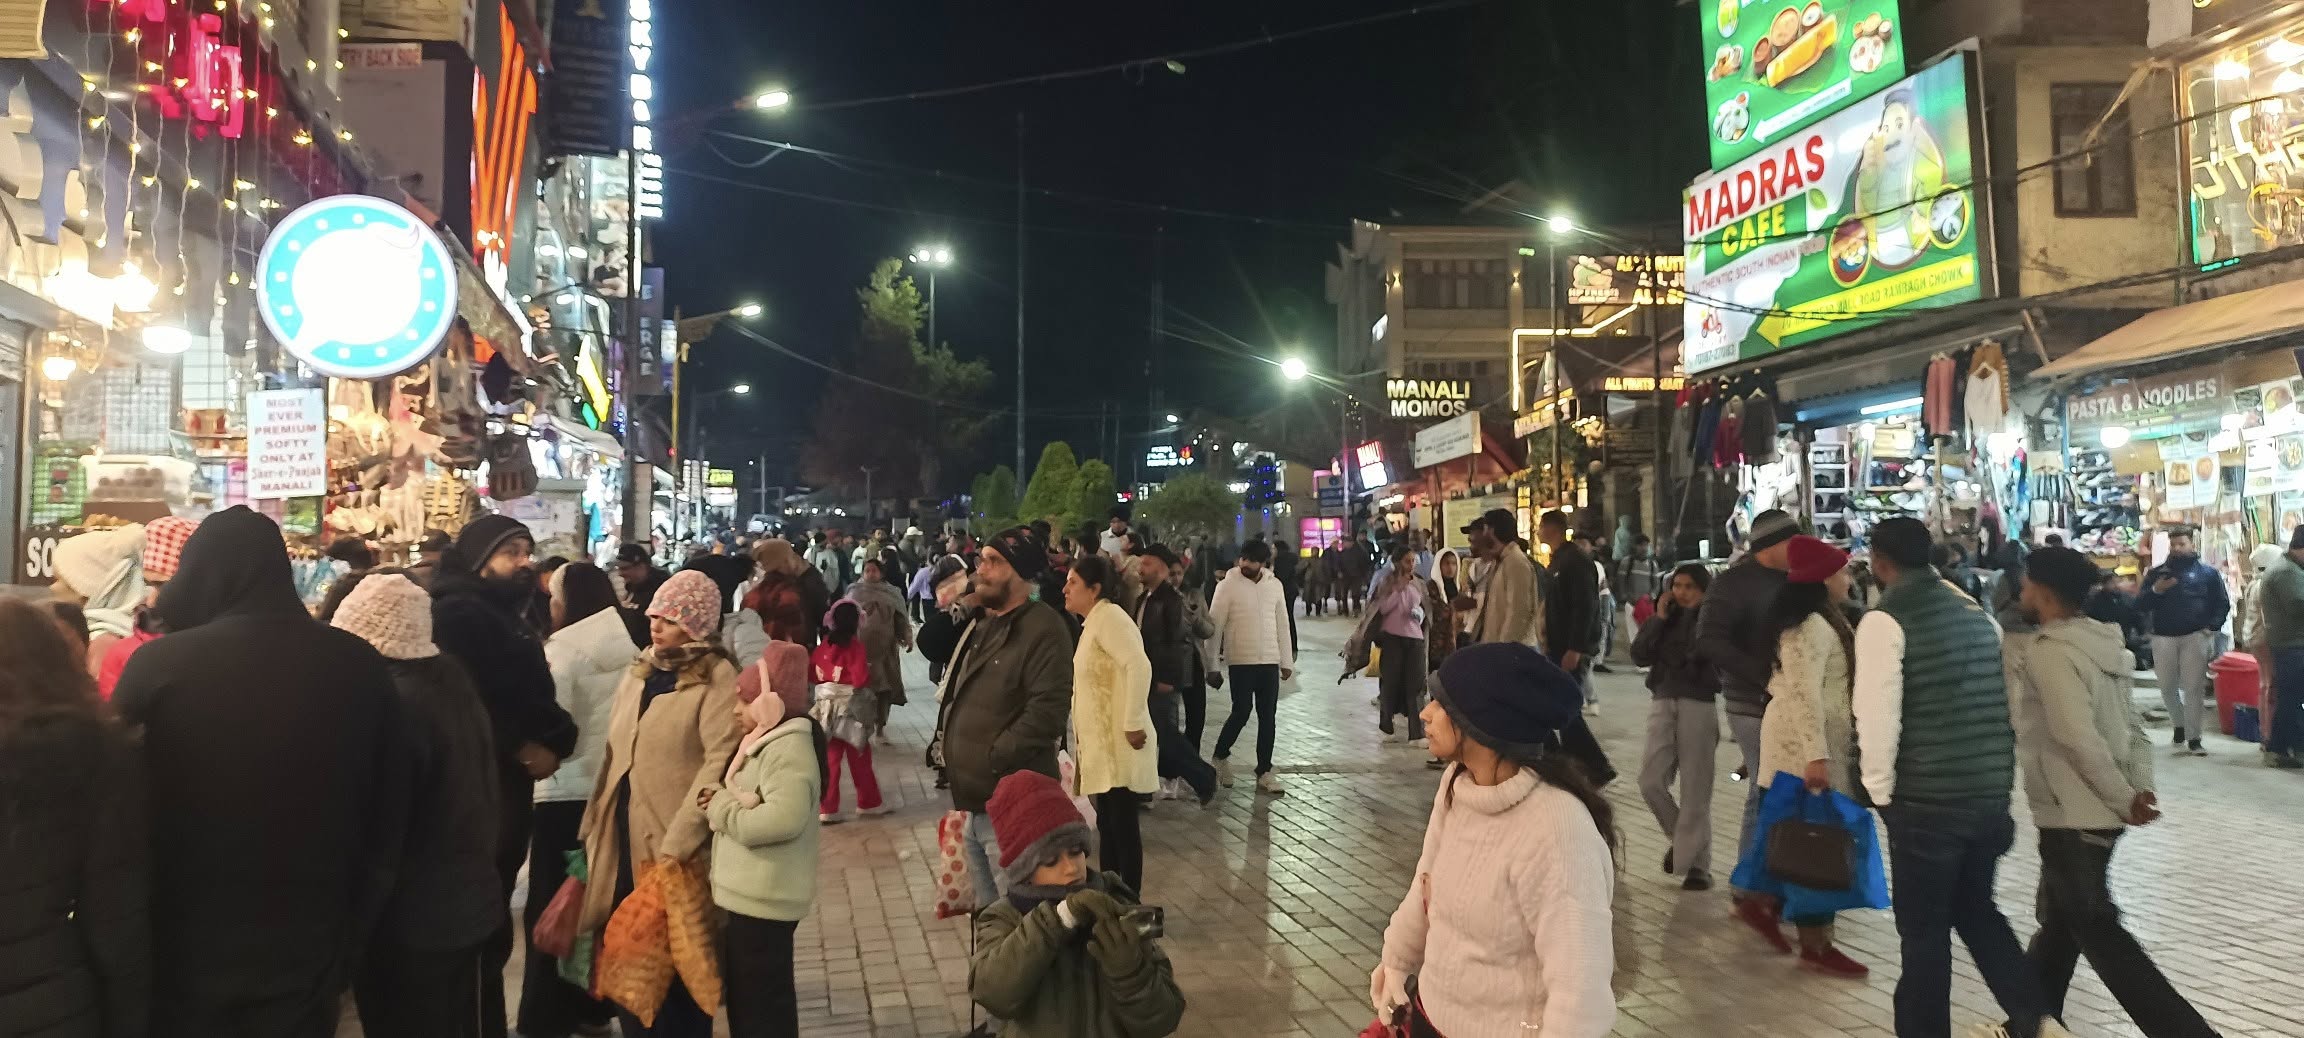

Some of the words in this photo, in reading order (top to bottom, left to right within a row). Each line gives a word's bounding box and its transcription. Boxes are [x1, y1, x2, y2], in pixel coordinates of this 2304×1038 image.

[1688, 134, 1825, 236] MADRAS
[1721, 203, 1786, 257] CAFE
[1735, 259, 1764, 278] SOUTH
[1766, 248, 1797, 268] INDIAN
[1928, 266, 1964, 288] CHOWK
[1386, 379, 1471, 399] MANALI
[266, 398, 304, 408] MOST
[2069, 396, 2117, 420] PASTA
[2121, 393, 2133, 412] &
[2138, 378, 2217, 410] NOODLES
[267, 412, 303, 421] EVER
[1391, 400, 1467, 417] MOMOS
[254, 424, 317, 435] PREMIUM
[265, 439, 308, 448] SOFTY
[259, 454, 294, 463] ONLY
[298, 452, 315, 462] AT
[260, 481, 312, 491] MANALI
[26, 536, 57, 578] SO
